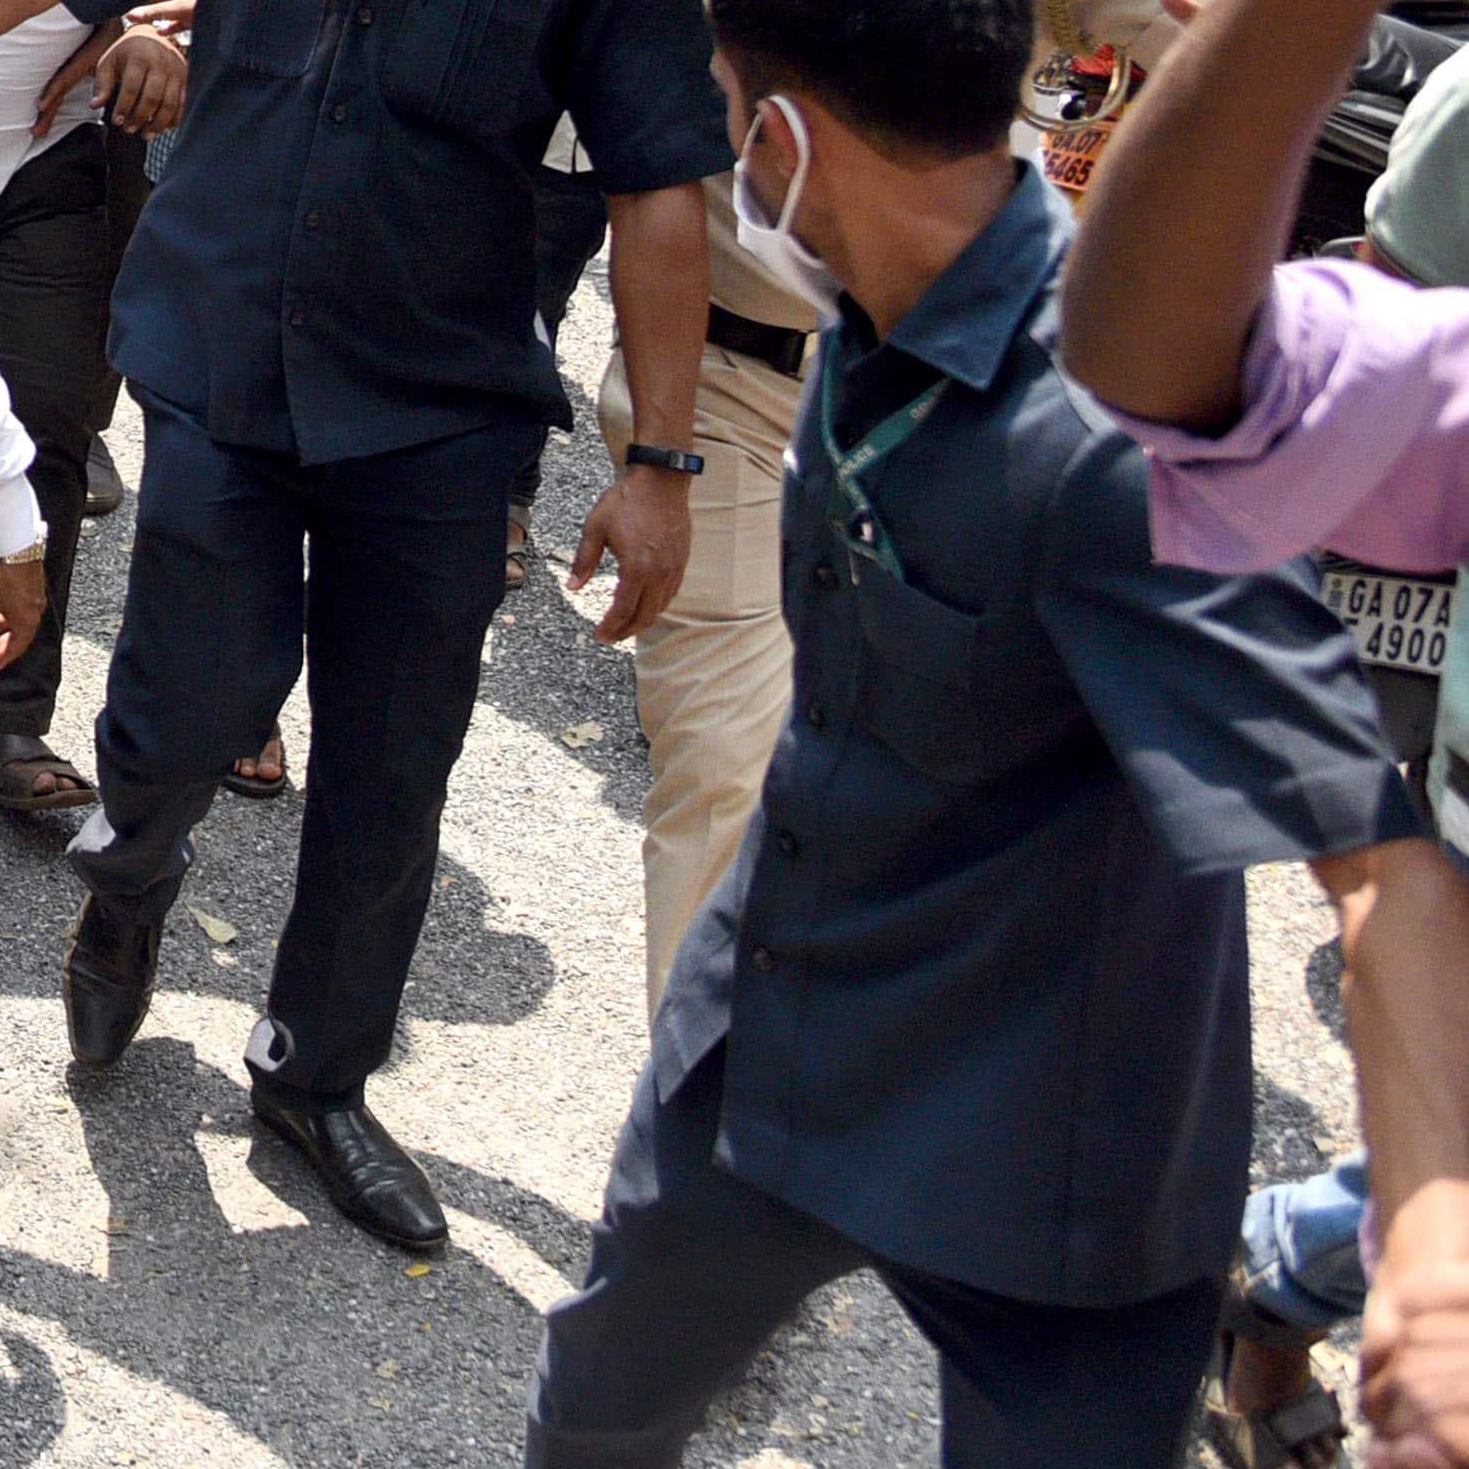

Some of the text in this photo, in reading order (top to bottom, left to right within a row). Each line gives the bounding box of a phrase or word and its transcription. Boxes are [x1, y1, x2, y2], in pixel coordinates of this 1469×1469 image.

[1347, 579, 1382, 618] GA
[1393, 585, 1452, 628] 07A
[1366, 622, 1447, 667] 4900
